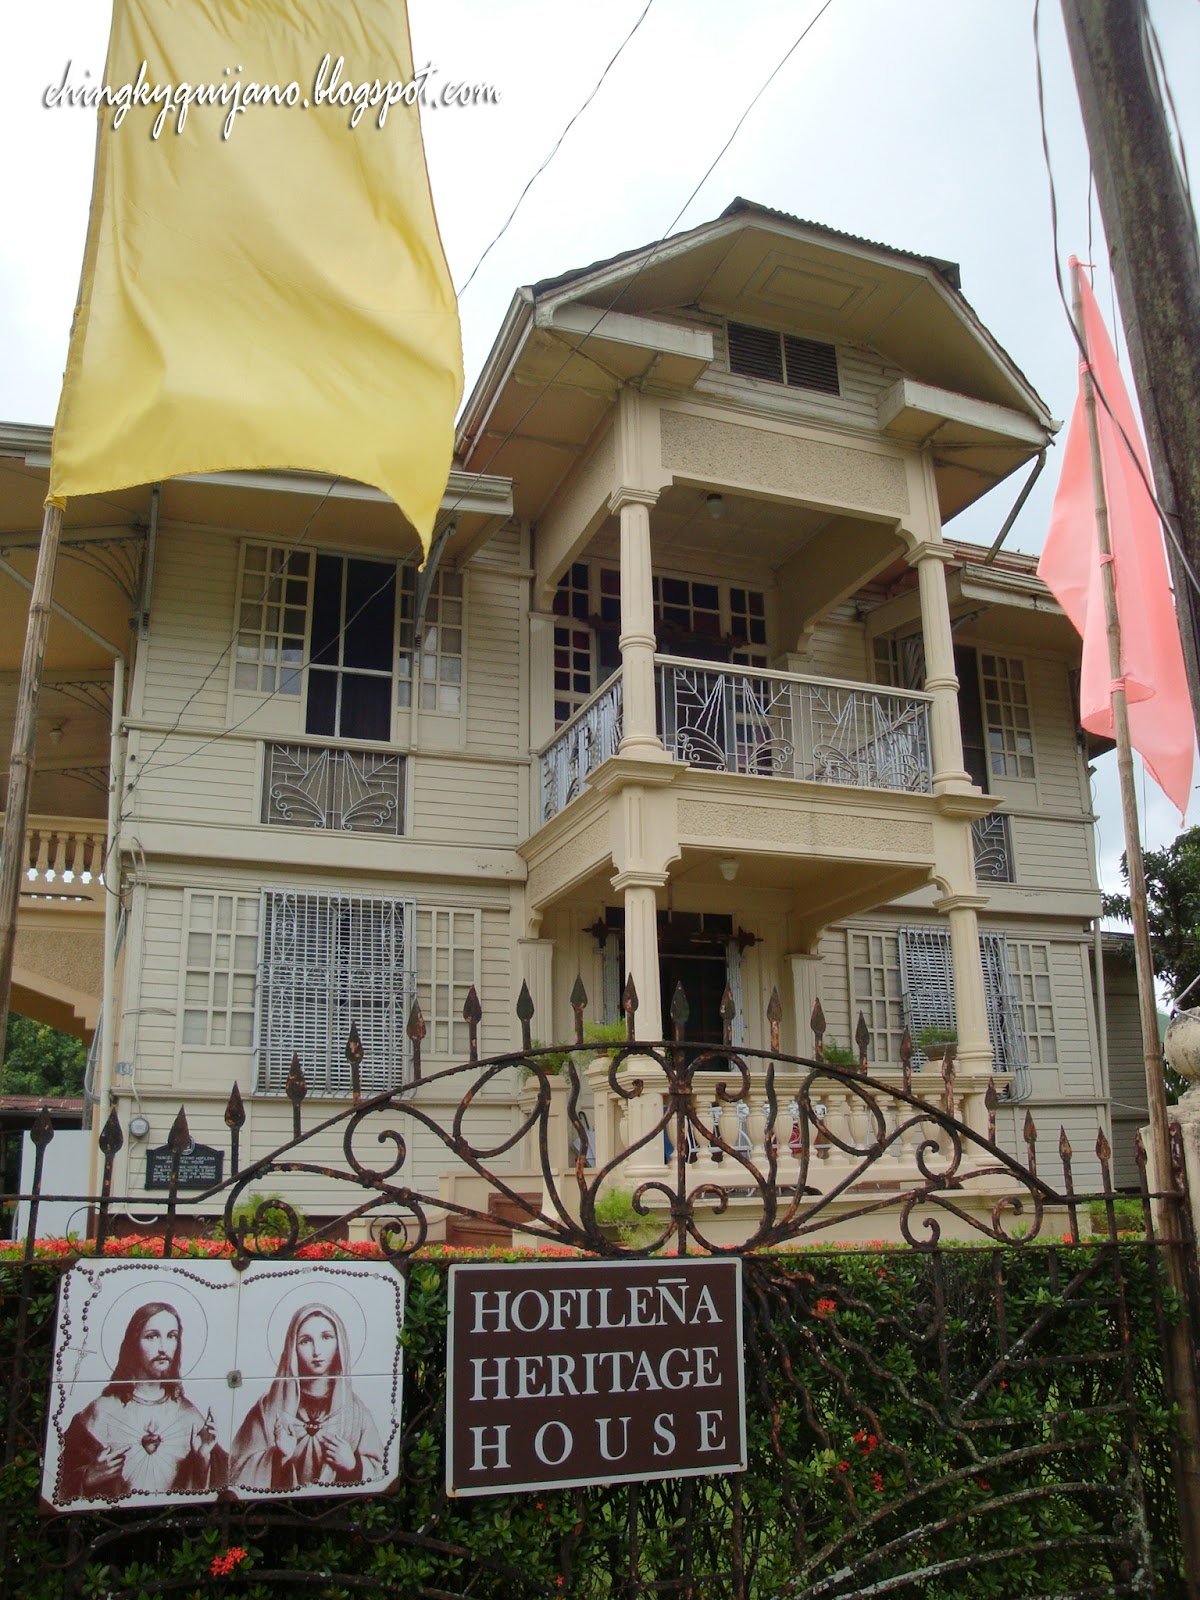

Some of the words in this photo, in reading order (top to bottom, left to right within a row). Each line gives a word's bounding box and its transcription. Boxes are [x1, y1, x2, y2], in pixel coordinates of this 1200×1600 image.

[469, 1278, 723, 1333] HOFILEÑA
[469, 1346, 723, 1401] HERITAGE
[469, 1410, 727, 1471] HOUSE
